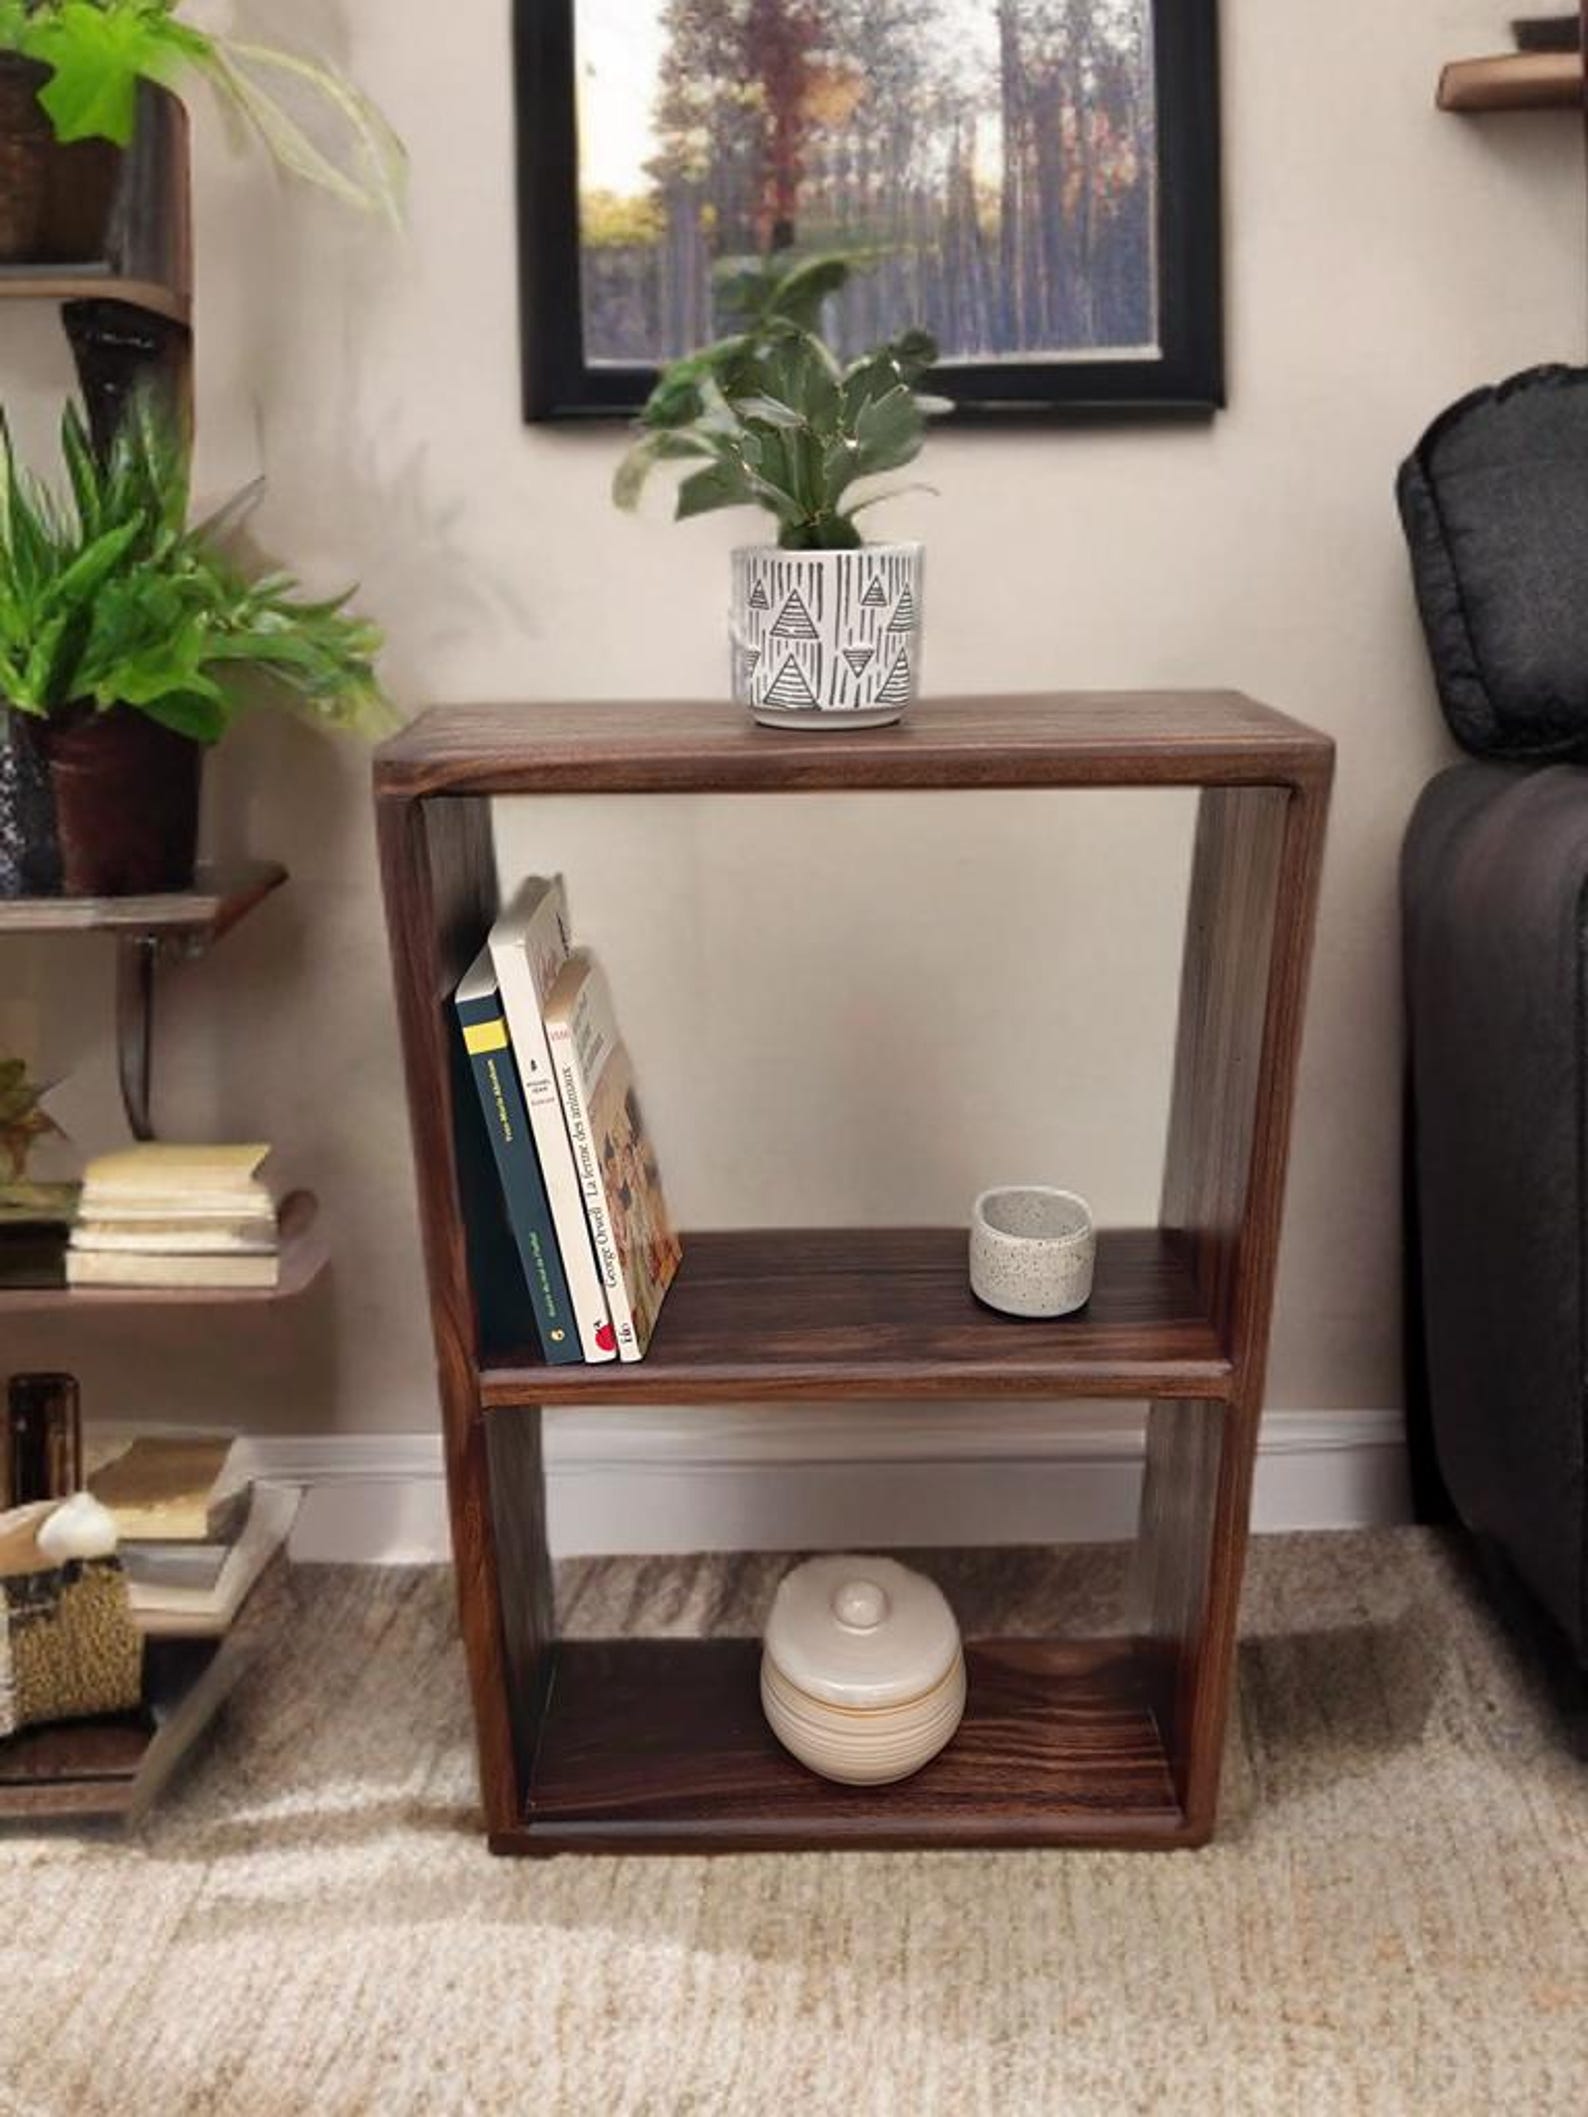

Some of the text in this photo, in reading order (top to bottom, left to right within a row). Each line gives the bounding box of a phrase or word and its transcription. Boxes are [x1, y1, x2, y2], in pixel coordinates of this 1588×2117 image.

[562, 1062, 617, 1288] George Orwell La ferme des animaux
